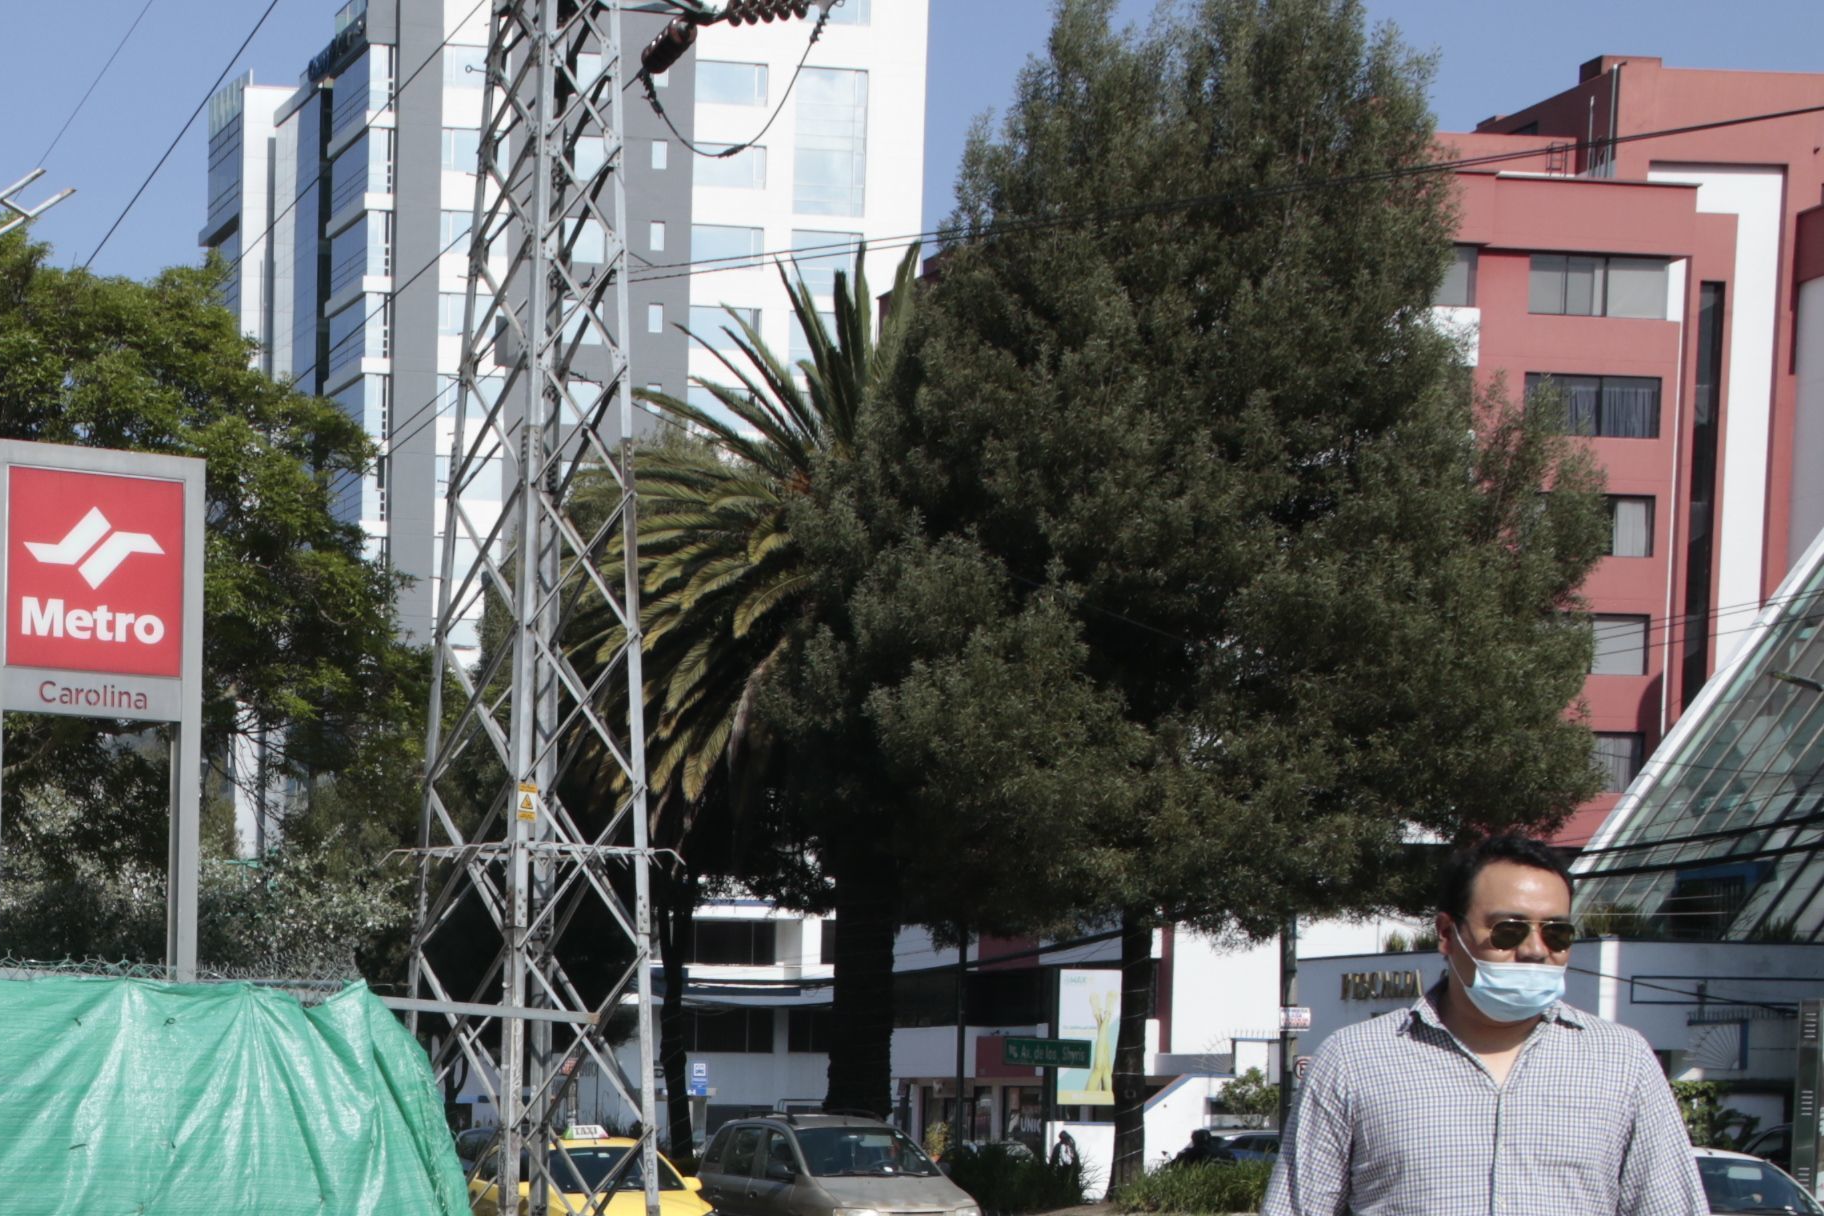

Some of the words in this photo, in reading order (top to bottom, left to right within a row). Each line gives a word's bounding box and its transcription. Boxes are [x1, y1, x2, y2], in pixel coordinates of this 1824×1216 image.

[21, 595, 165, 645] Metro
[38, 680, 148, 710] Carolina
[575, 1126, 598, 1136] TAXI
